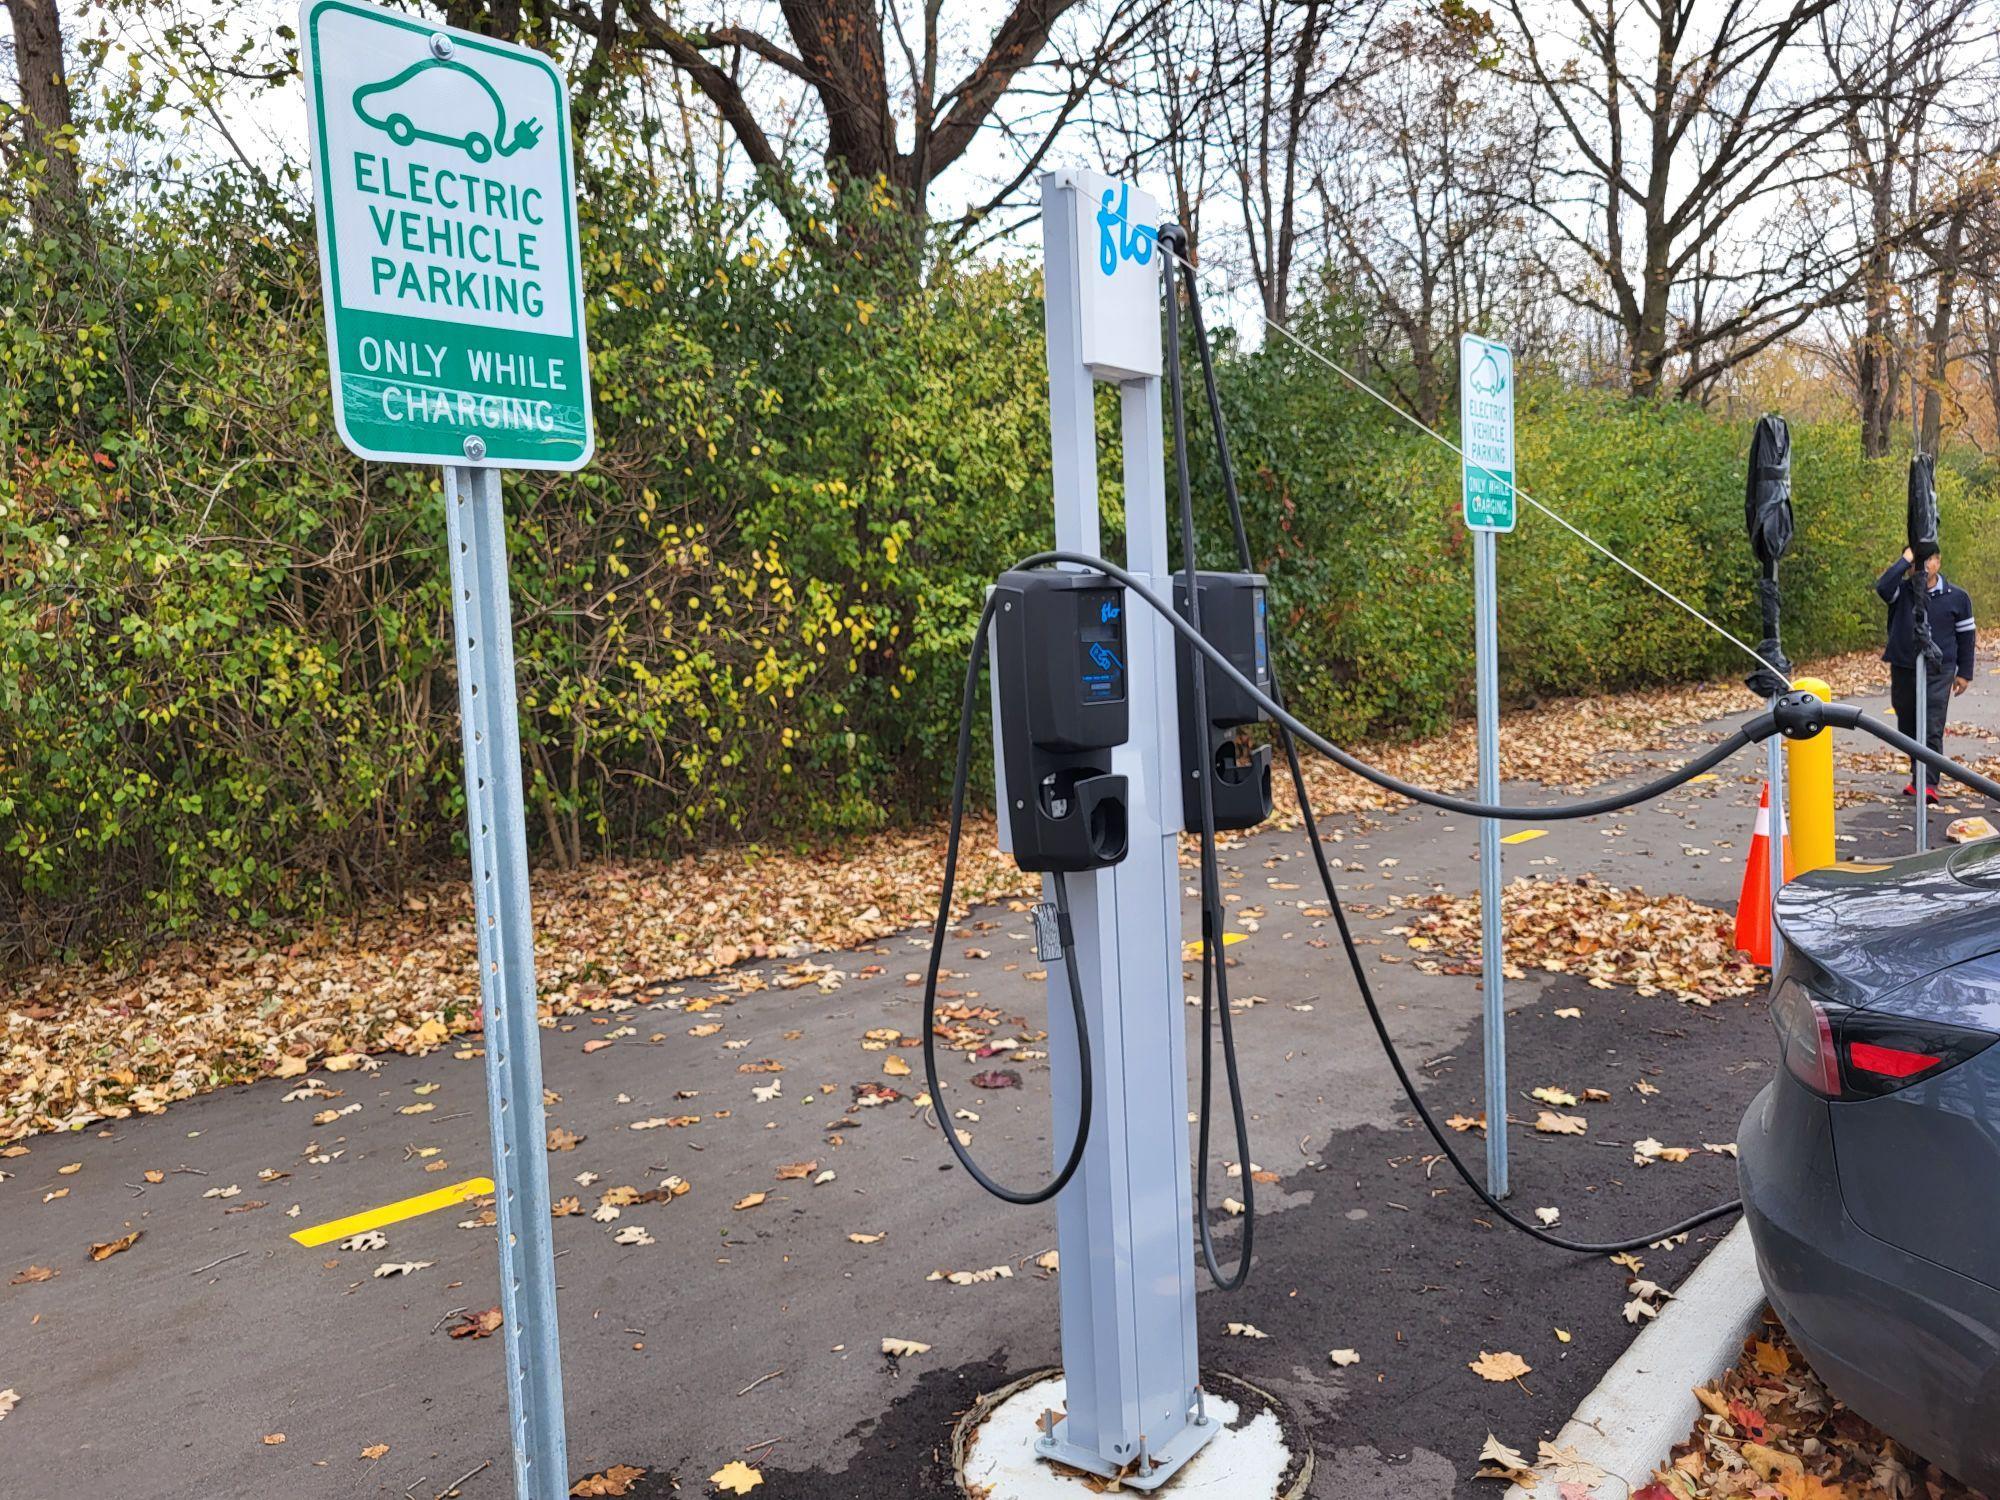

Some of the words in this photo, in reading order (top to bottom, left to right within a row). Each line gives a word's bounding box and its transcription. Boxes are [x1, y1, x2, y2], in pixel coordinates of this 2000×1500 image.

[353, 152, 544, 225] ELECTRIC
[369, 206, 540, 271] VEHICLE
[1097, 183, 1158, 276] flo
[371, 256, 544, 317] PARKING
[359, 336, 448, 378] ONLY
[467, 348, 566, 390] WHILE
[382, 387, 554, 431] CHARGING
[1469, 399, 1506, 422] ELECTRIC
[1471, 421, 1505, 443] VEHICLE
[1471, 442, 1506, 464] PARKING
[1469, 476, 1487, 493] ONLY
[1471, 496, 1508, 515] CHARGING
[1101, 601, 1120, 624] flo
